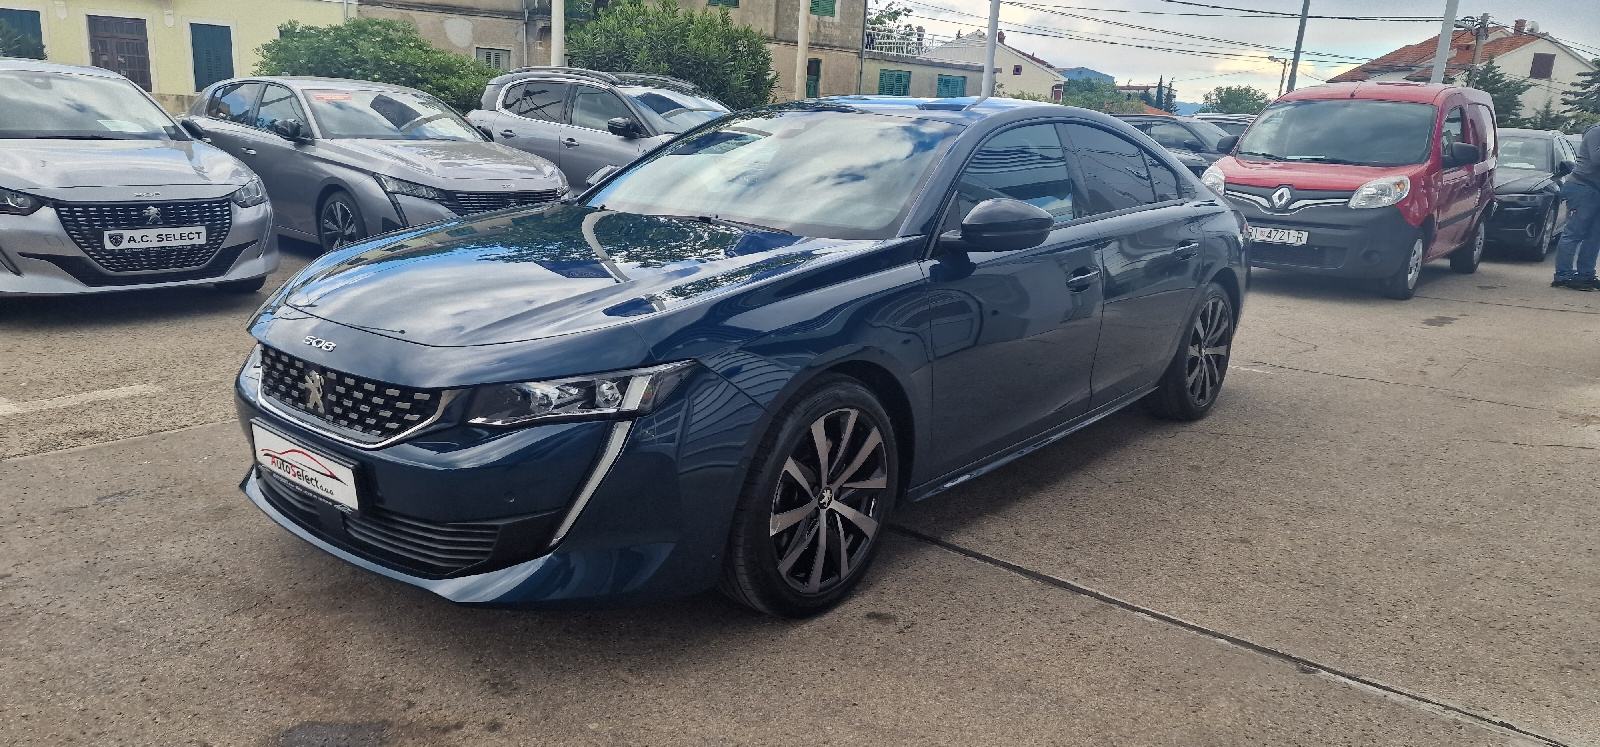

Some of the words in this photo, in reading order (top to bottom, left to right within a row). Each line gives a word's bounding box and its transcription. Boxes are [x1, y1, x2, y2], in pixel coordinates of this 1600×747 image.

[127, 235, 152, 244] A.C.
[156, 232, 203, 242] SELECT
[1266, 230, 1304, 242] 4721-R
[302, 335, 337, 350] 508
[271, 455, 320, 490] AutoSelect
